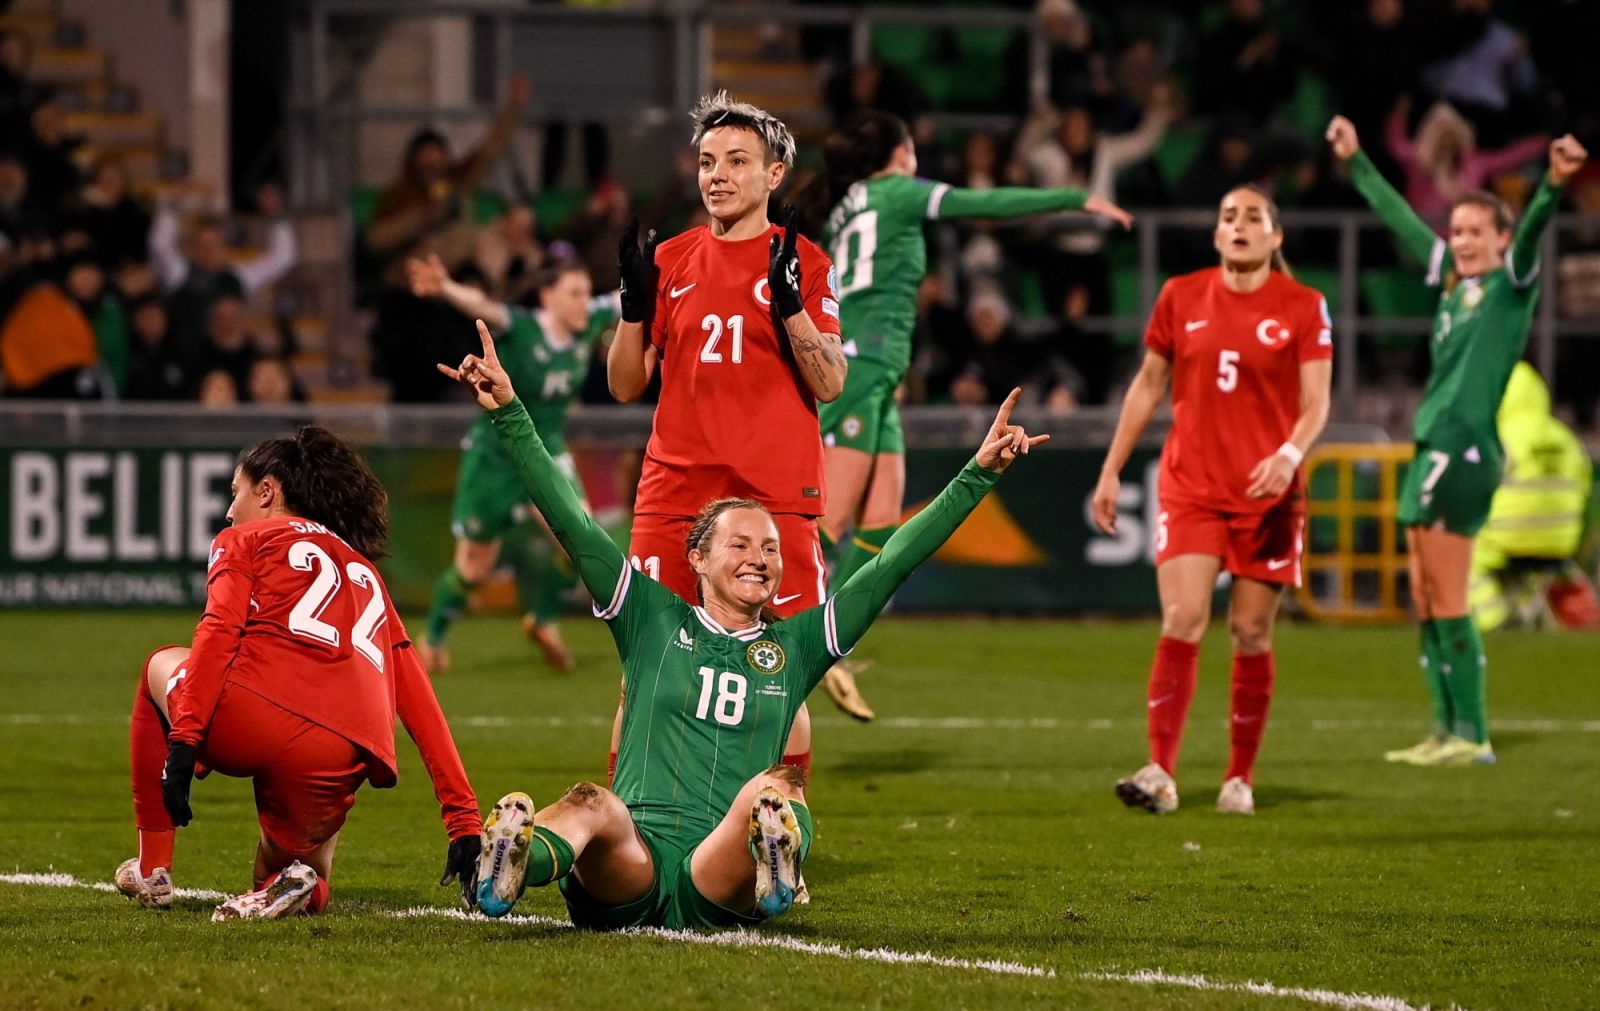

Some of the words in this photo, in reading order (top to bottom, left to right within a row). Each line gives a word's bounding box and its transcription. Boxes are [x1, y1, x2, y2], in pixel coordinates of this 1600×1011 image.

[701, 314, 743, 363] 21
[1216, 350, 1240, 392] 5
[1420, 450, 1450, 506] 7
[288, 540, 387, 674] 22
[695, 666, 747, 726] 18
[492, 842, 506, 880] TIEMPO
[769, 843, 778, 881] TIEMPO
